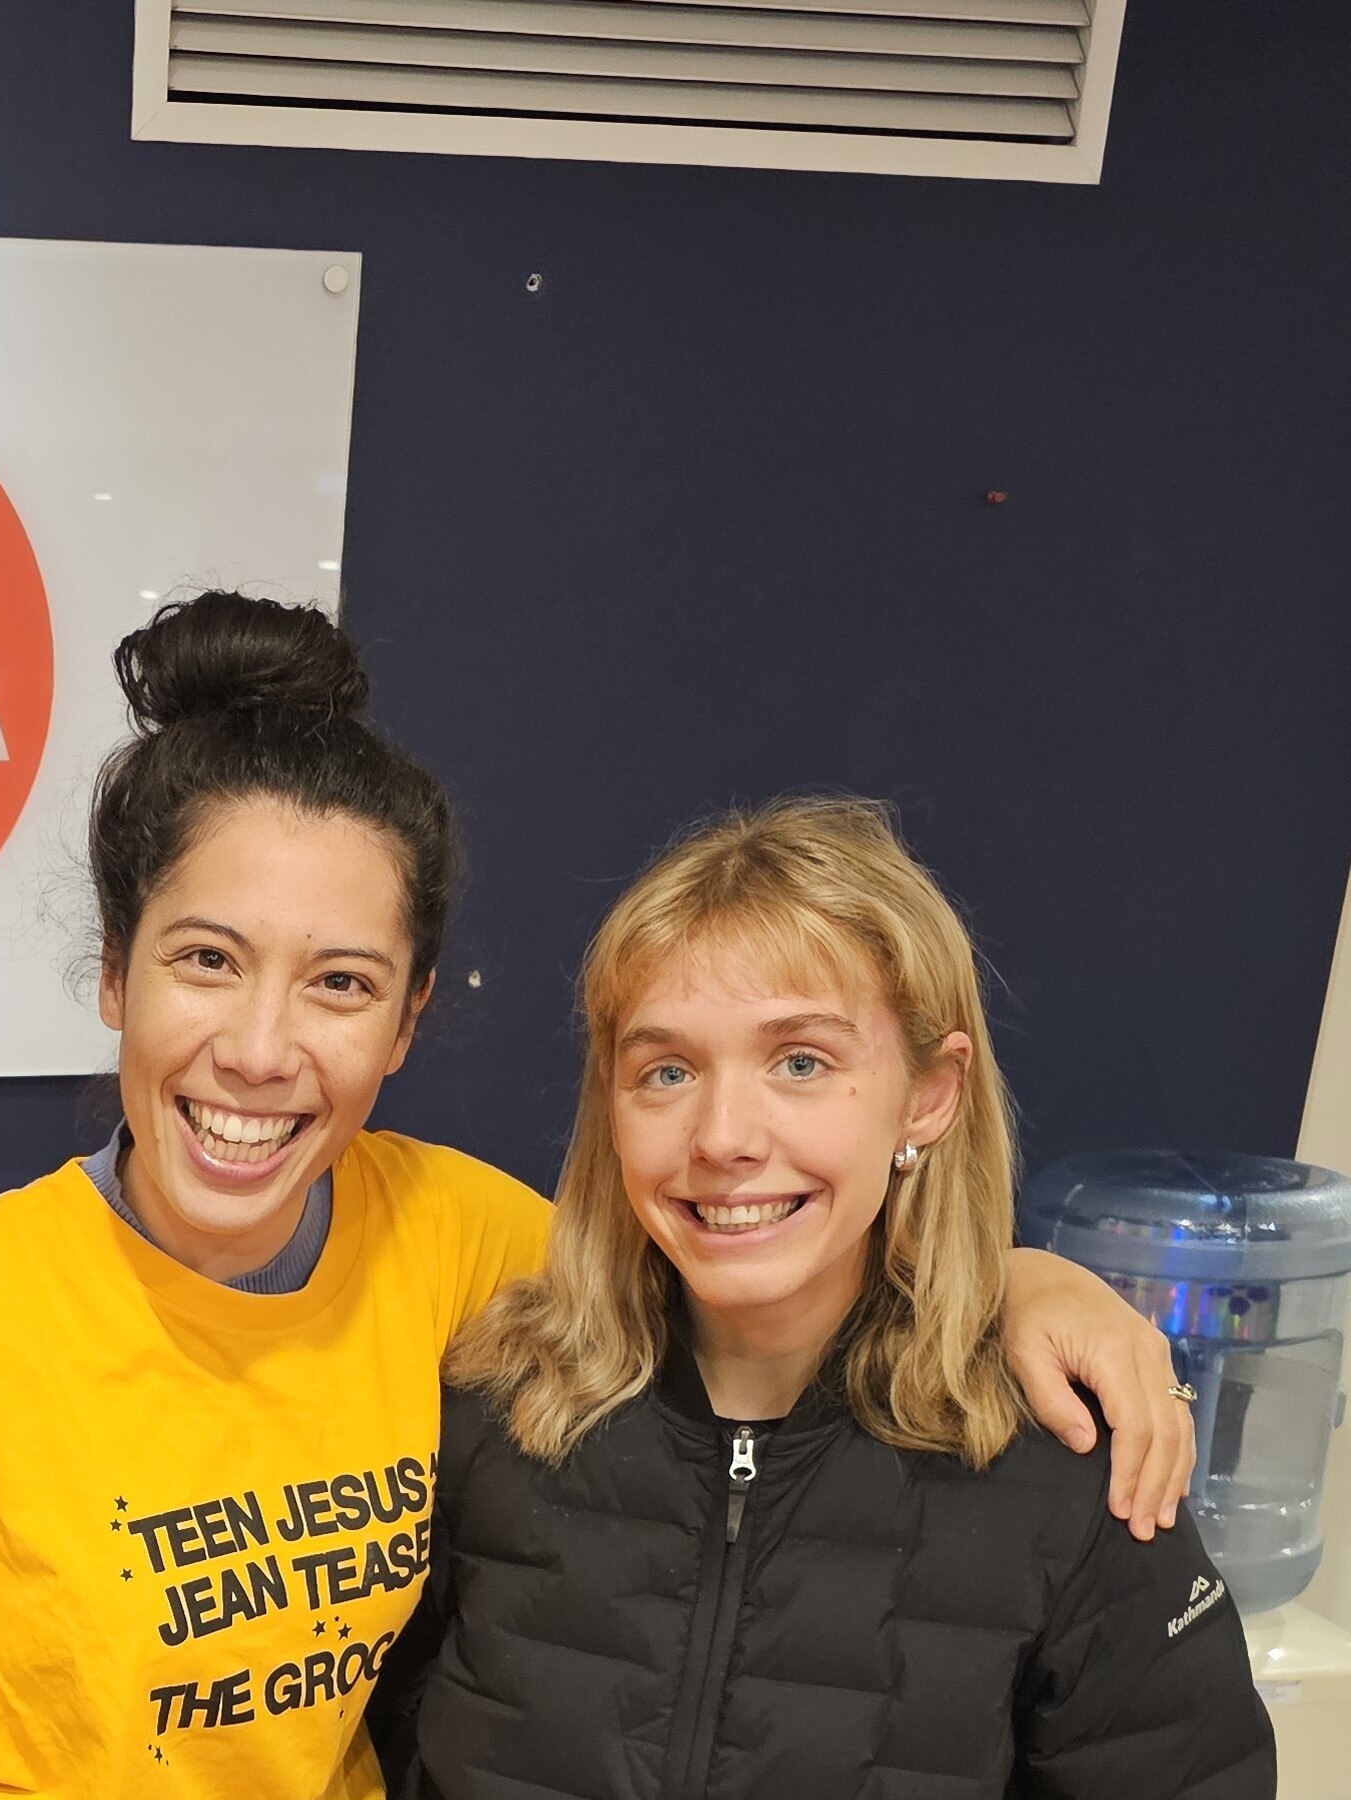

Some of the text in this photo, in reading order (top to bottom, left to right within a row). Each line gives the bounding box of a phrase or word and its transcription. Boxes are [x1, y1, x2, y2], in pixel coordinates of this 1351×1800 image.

[128, 1491, 270, 1574] TEEN
[276, 1457, 428, 1542] JESUS
[158, 1554, 288, 1646] JEAN
[149, 1669, 255, 1736] THE
